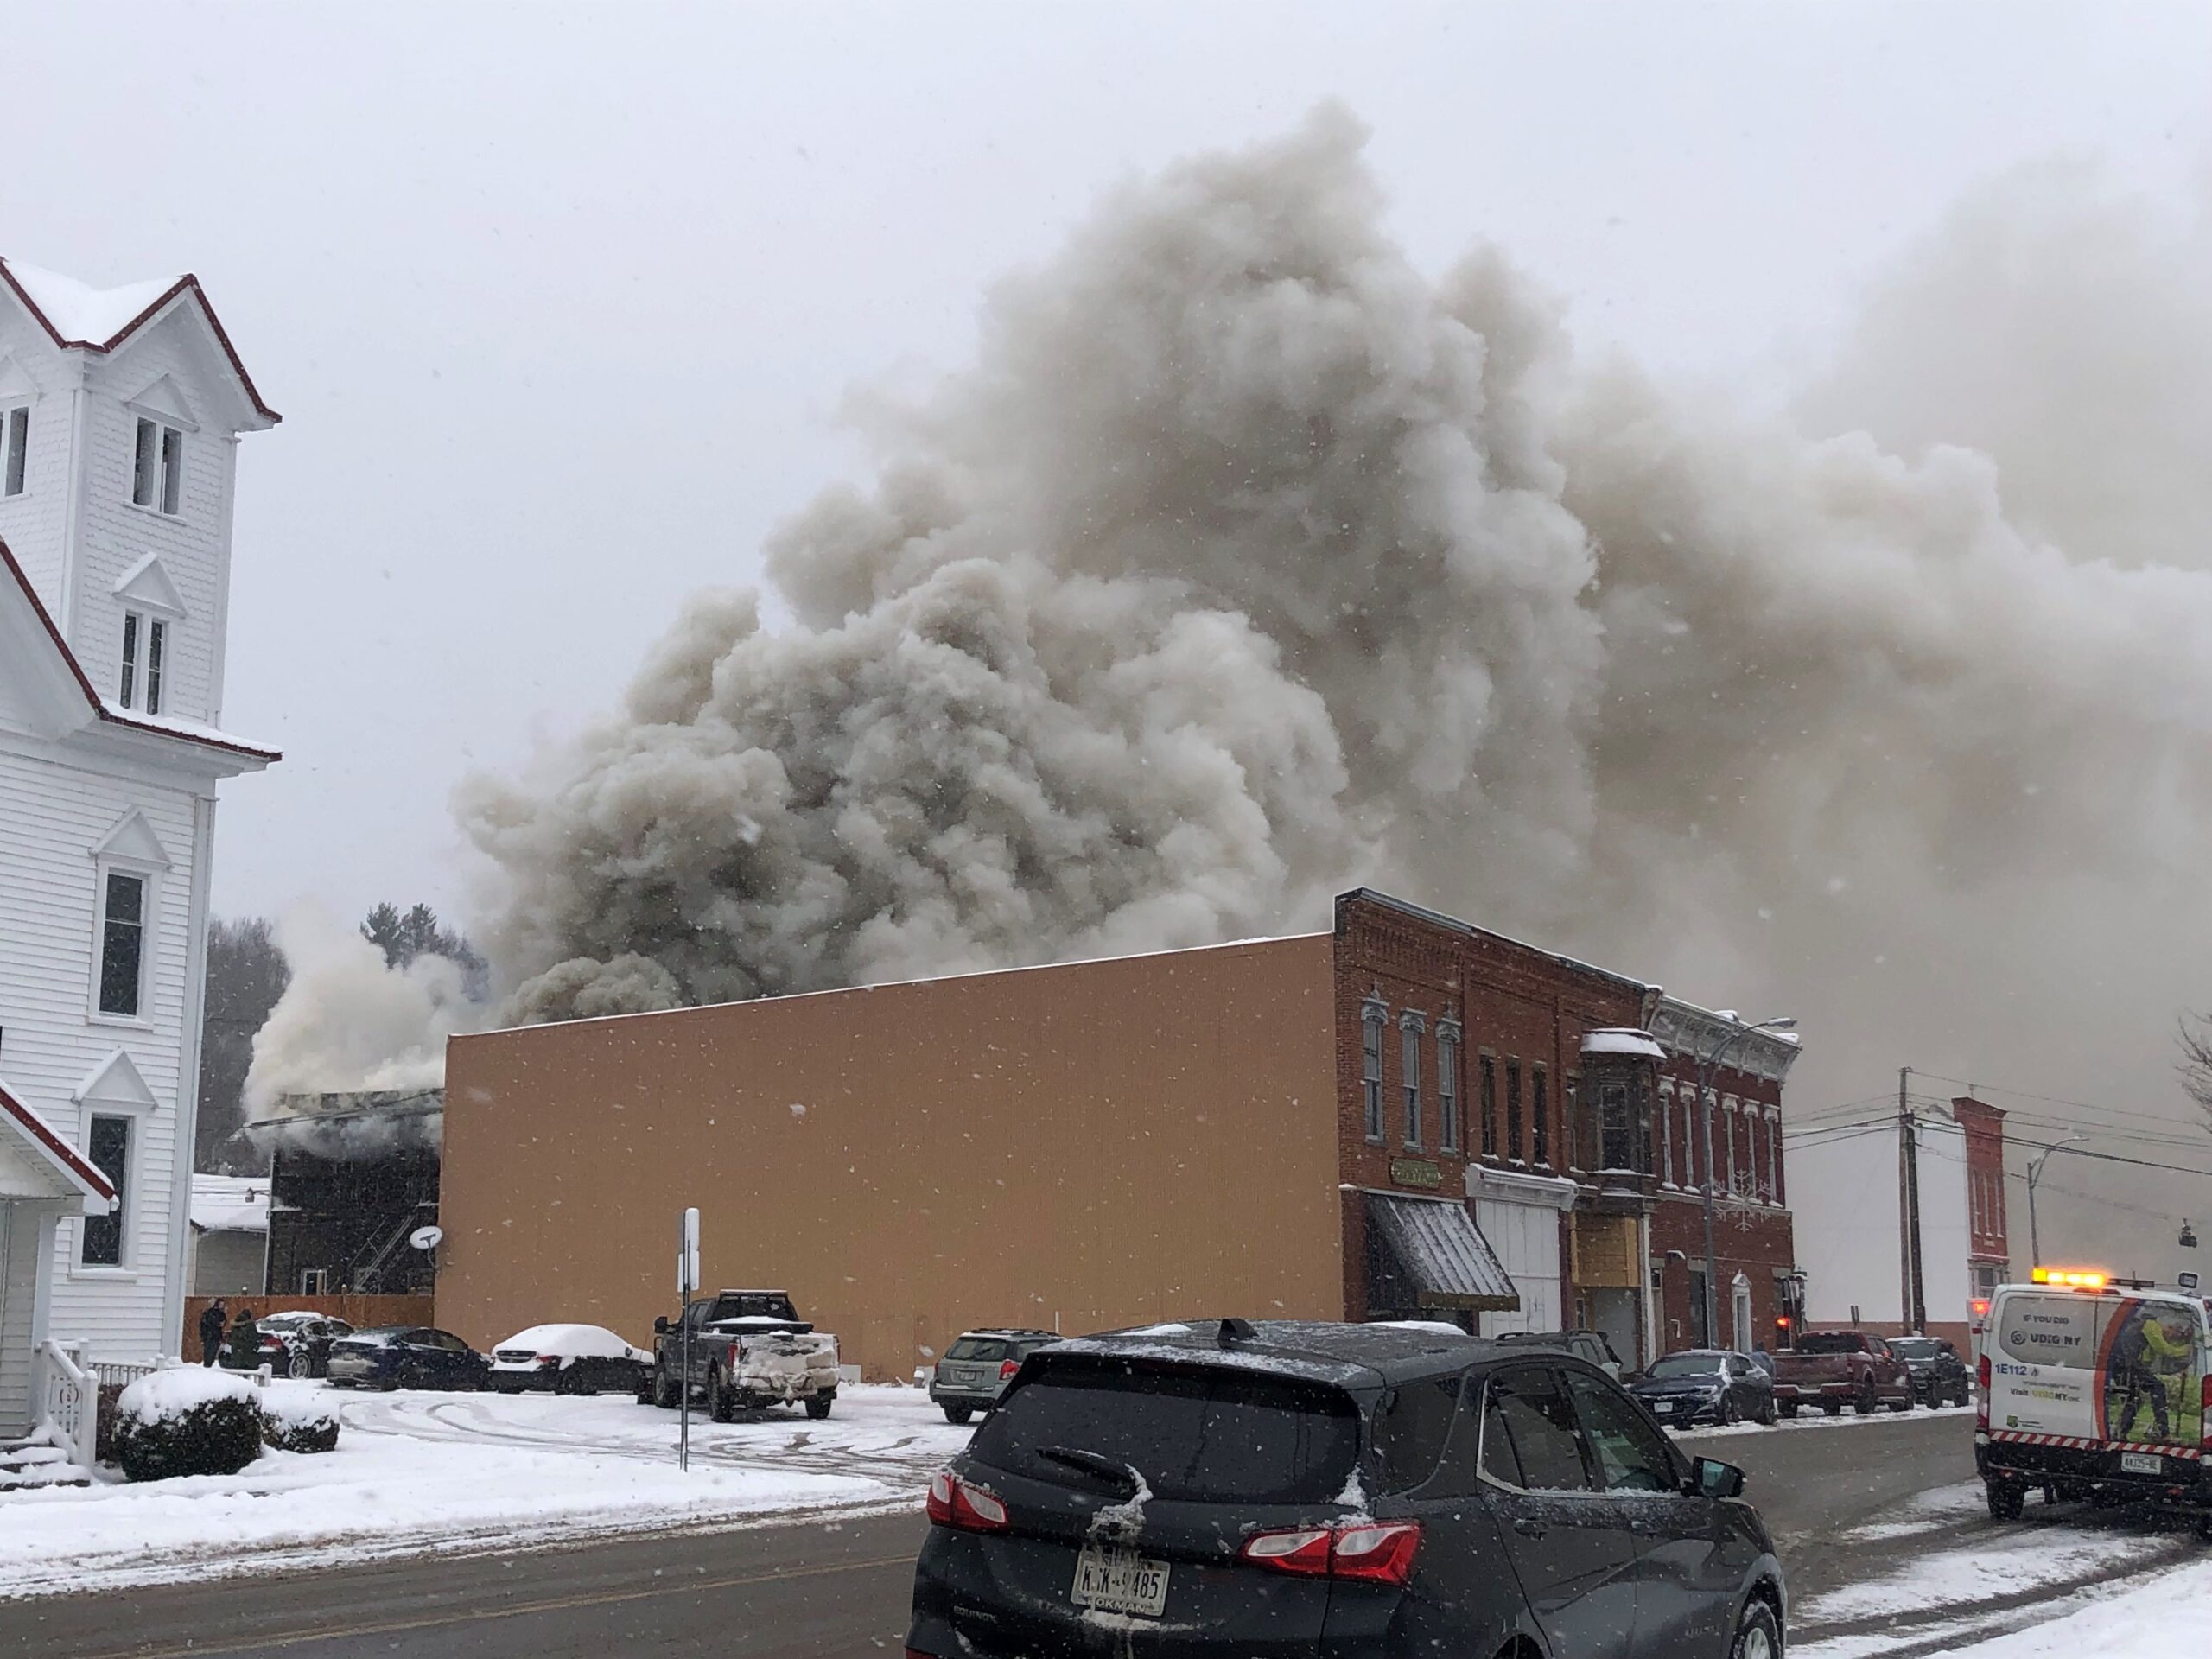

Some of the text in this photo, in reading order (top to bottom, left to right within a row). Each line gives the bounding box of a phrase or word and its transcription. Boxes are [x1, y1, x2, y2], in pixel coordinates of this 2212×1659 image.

[2033, 1315, 2052, 1324] YOU
[2063, 1335, 2082, 1346] NY
[1995, 1363, 2027, 1376] 1E112
[2010, 1388, 2029, 1396] Visit
